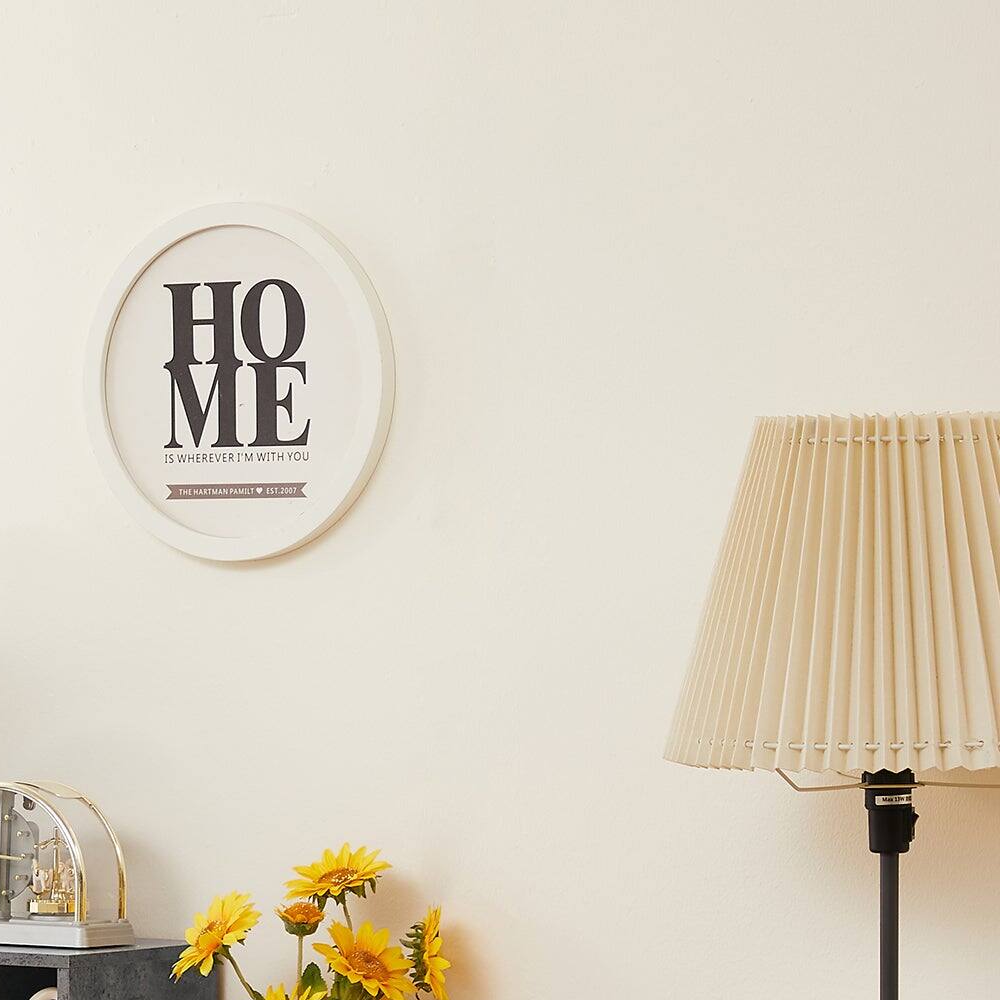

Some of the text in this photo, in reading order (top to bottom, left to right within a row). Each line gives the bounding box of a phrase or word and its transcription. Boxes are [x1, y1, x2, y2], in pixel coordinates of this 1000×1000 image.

[164, 451, 310, 464] IS WHEREVER I'M WITH YOU
[178, 488, 192, 496] THE
[193, 487, 229, 496] HARTMAN
